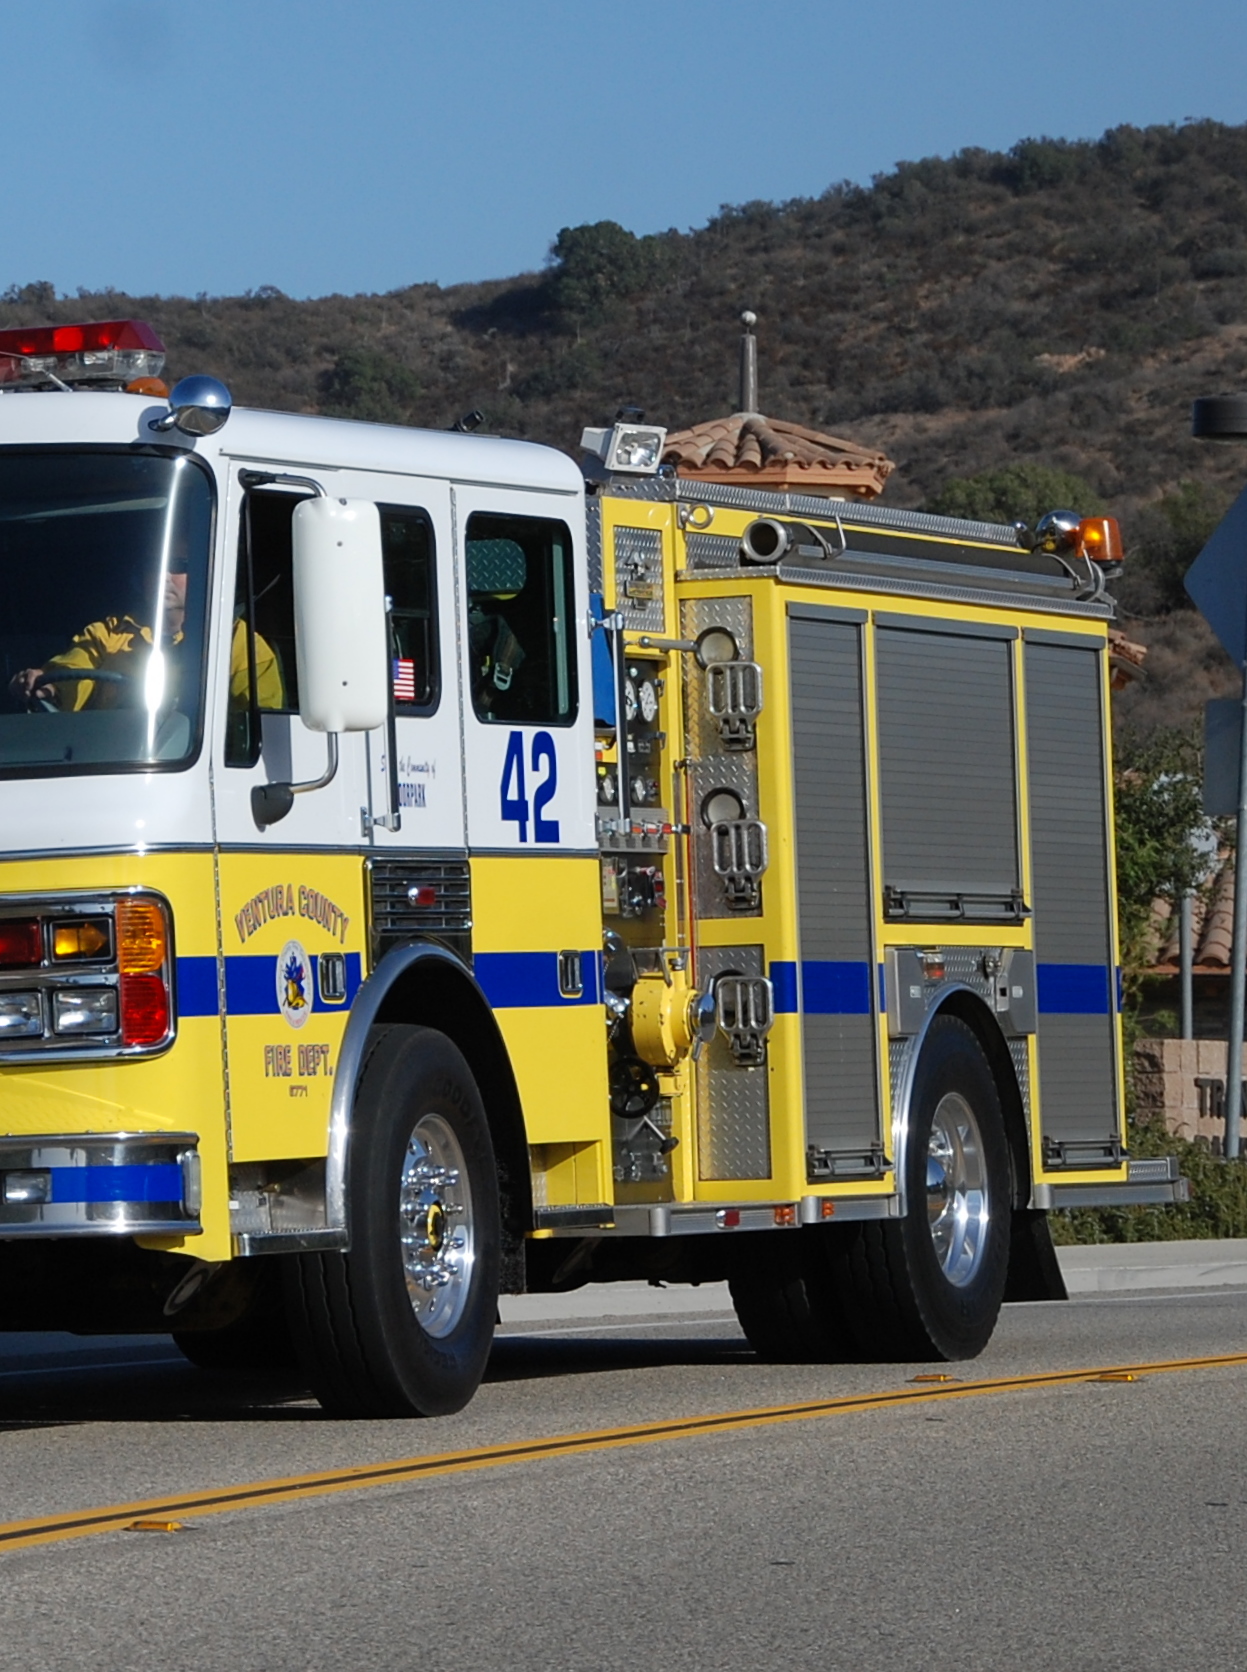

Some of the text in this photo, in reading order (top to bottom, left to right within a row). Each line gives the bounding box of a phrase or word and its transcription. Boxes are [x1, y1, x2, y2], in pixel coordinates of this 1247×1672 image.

[398, 783, 426, 808] OORPARK
[500, 731, 560, 843] 42
[234, 883, 350, 944] VENTURA COUNTY
[264, 1044, 333, 1077] FIRE DEPT.
